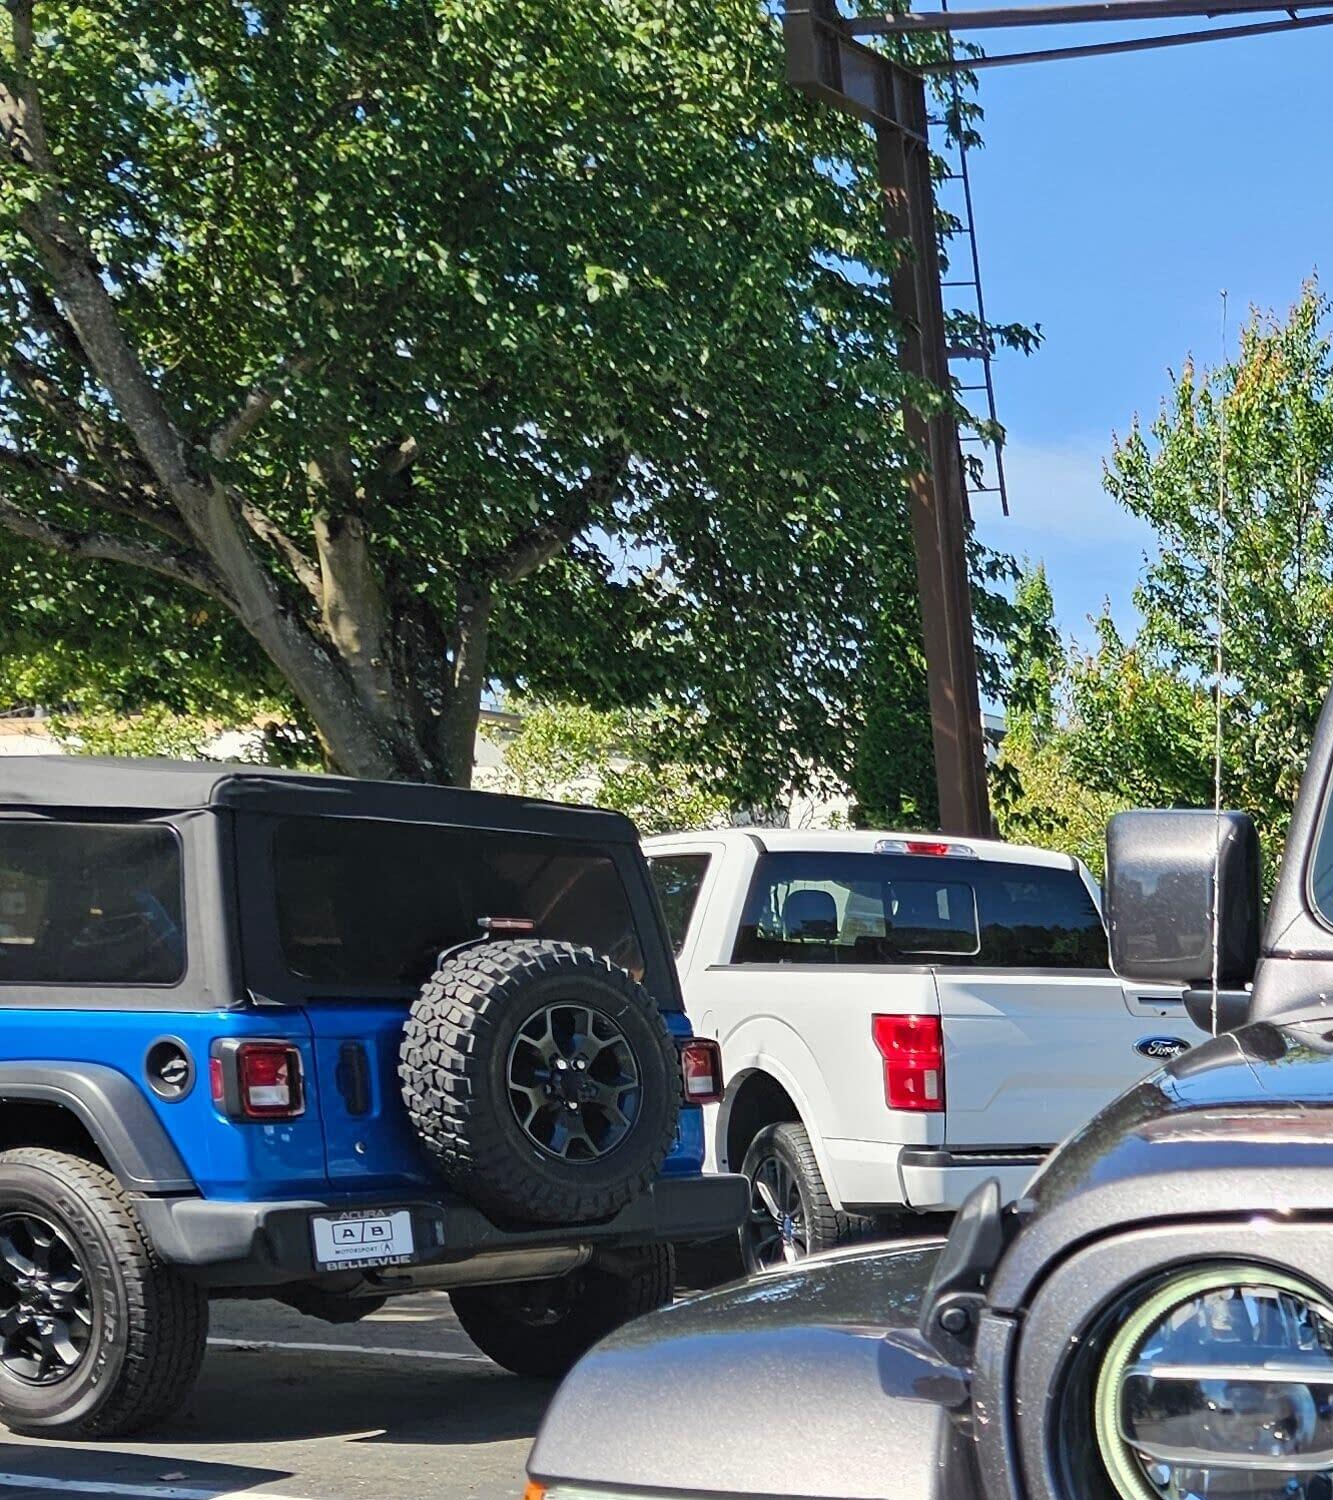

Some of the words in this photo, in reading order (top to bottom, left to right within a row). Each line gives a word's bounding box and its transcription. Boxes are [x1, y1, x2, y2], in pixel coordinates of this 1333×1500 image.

[340, 1209, 386, 1221] ACURA
[335, 1246, 378, 1255] MOTORSPORT
[326, 1255, 411, 1271] BELLEVUE
